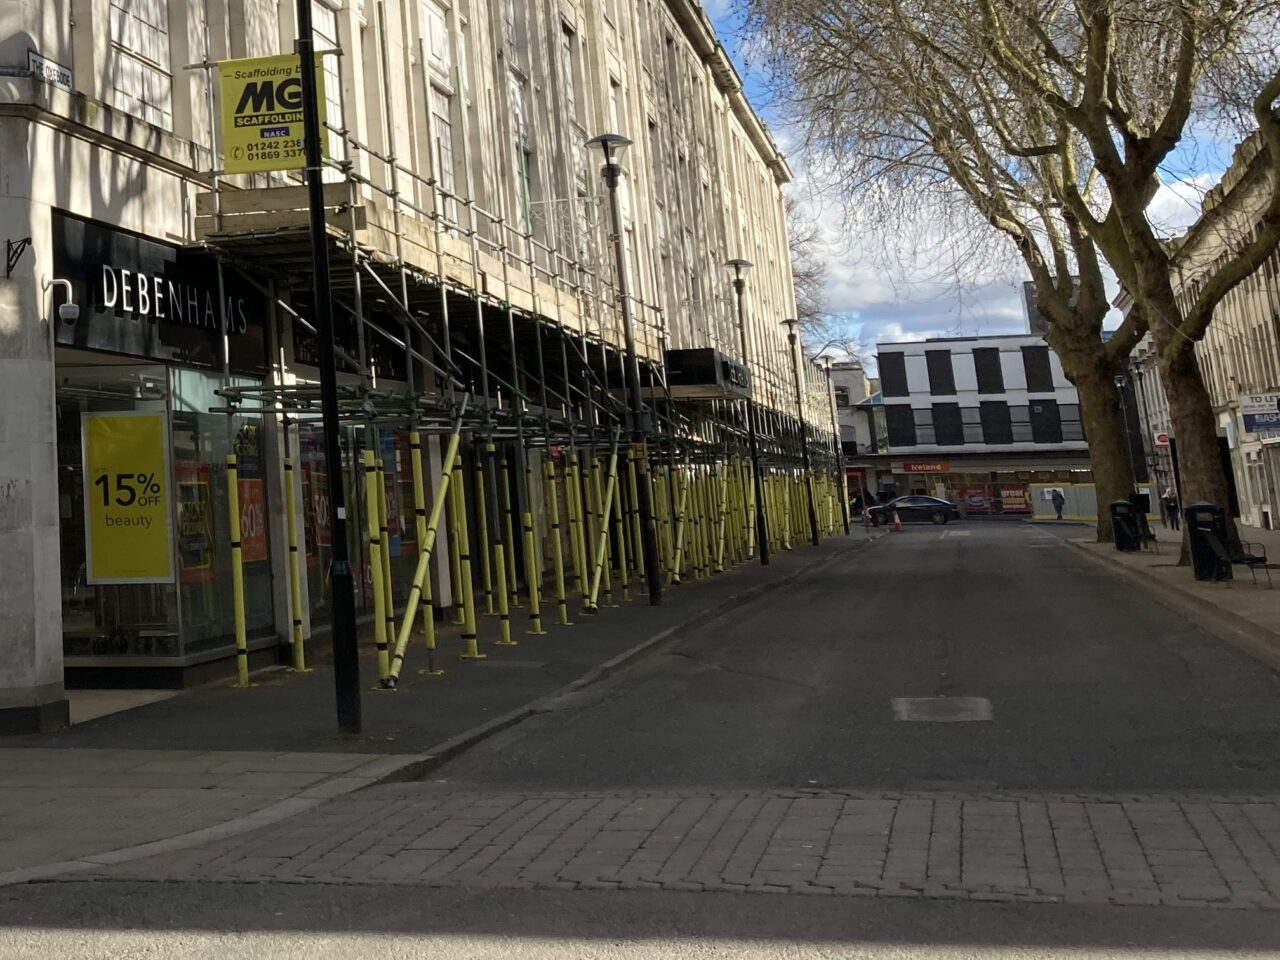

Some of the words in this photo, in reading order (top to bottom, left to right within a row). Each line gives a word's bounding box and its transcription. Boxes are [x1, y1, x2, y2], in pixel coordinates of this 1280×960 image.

[234, 66, 293, 80] Scaffolding
[236, 112, 305, 127] SCAFFOLDIN
[263, 130, 287, 138] NASC
[247, 141, 280, 152] 01242
[247, 150, 280, 161] 01869
[1249, 396, 1262, 404] TO
[910, 463, 943, 472] Iceland
[94, 472, 161, 508] 15%
[137, 496, 161, 507] OFF
[105, 513, 153, 530] beauty
